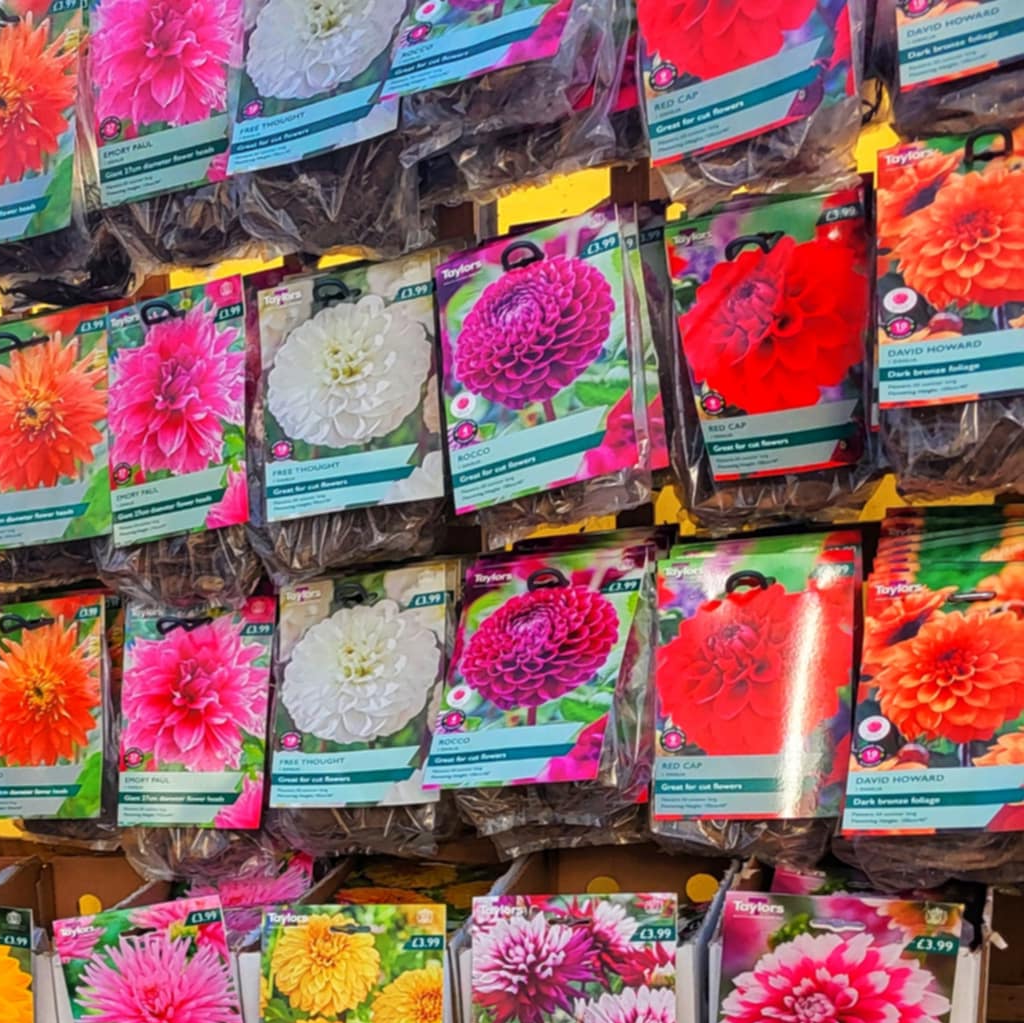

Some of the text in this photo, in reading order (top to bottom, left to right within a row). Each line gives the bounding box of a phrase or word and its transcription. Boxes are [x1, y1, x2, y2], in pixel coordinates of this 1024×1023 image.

[906, 7, 1000, 38] DAVID HOWARD
[908, 47, 930, 60] Dark
[932, 39, 965, 55] bronze
[654, 91, 699, 112] RED CAP
[656, 100, 745, 133] Great for cut flowers
[884, 148, 936, 166] Taylors
[826, 206, 856, 222] £3.99
[587, 237, 617, 255] £3.99
[442, 259, 482, 280] Taylors
[401, 284, 428, 299] £3.99
[218, 306, 241, 320] £3.99
[80, 319, 105, 333] £3.99
[887, 339, 982, 358] DAVID HOWARD
[887, 361, 980, 379] Dark bronze foliage
[708, 421, 747, 433] RED CAP
[713, 436, 789, 452] Great for cut flowers
[457, 447, 490, 461] ROCCO
[272, 461, 340, 477] FREE THOUGHT
[459, 456, 536, 482] Great for cut flowers
[474, 572, 513, 582] Taylors
[608, 580, 638, 594] £3.99
[876, 582, 923, 595] Taylors
[414, 592, 441, 605] £3.99
[246, 624, 270, 633] £3.99
[438, 736, 470, 746] ROCCO
[301, 757, 344, 766] THOUGHT
[661, 762, 702, 770] RED CAP
[278, 774, 351, 784] Great for cut flowers
[855, 774, 945, 785] DAVID HOWARD
[660, 782, 742, 792] Great for cut flowers
[853, 794, 940, 806] Dark bronze foliage
[733, 900, 784, 915] Taylors
[191, 911, 217, 923] £3.99
[59, 924, 97, 937] Taylors
[640, 928, 672, 940] £3.99
[4, 935, 28, 946] £3.99
[412, 937, 440, 948] £3.99
[916, 939, 953, 952] £3.99
